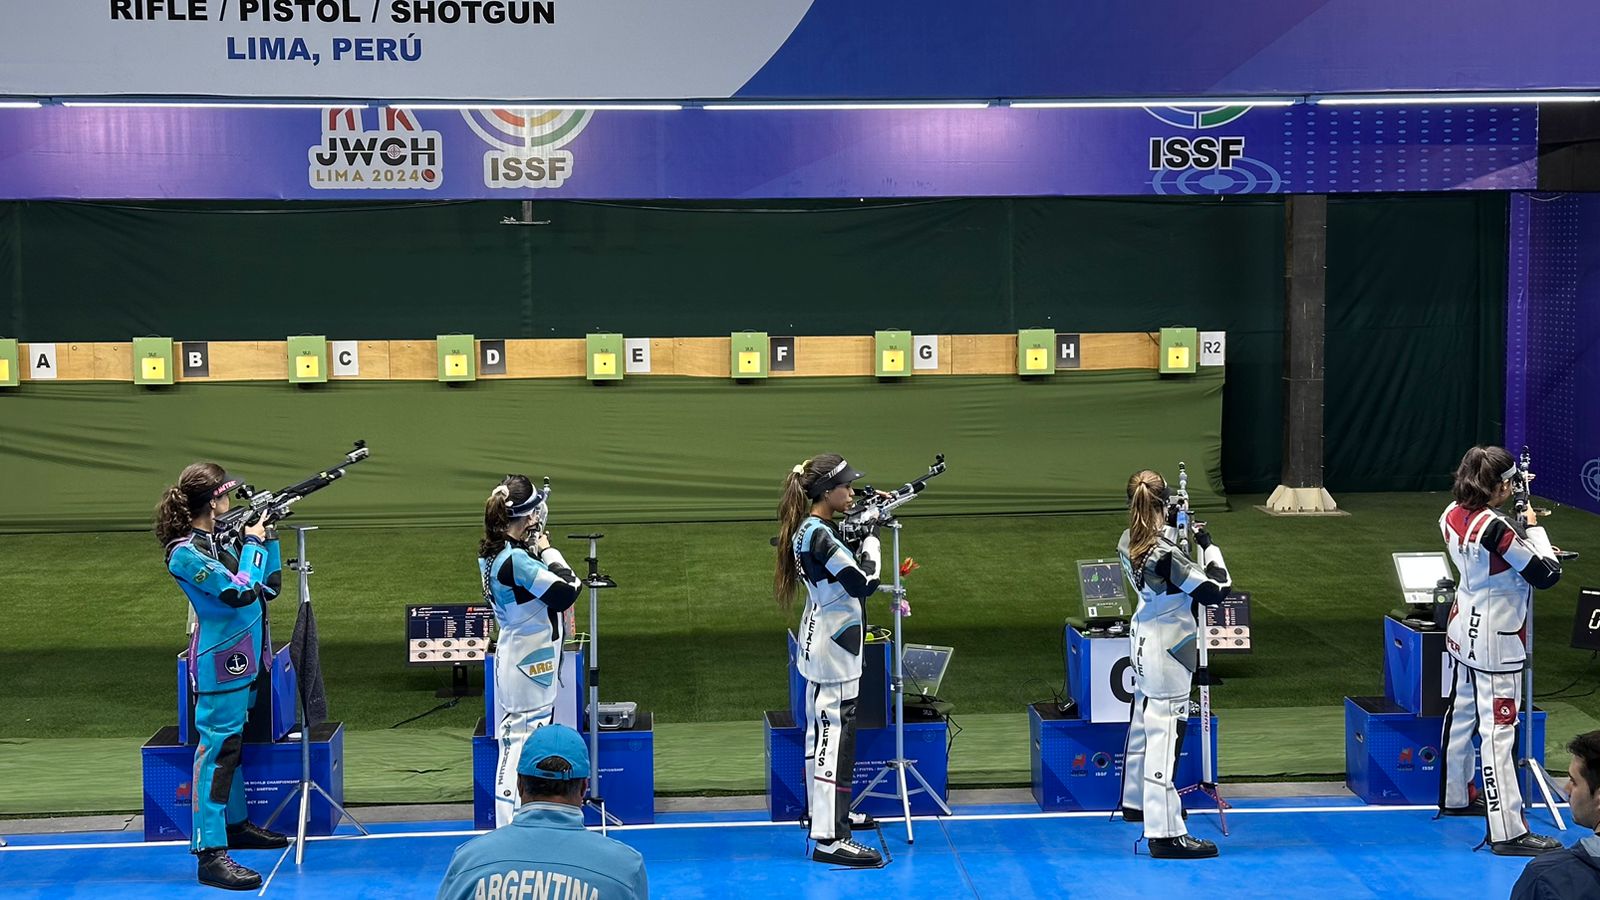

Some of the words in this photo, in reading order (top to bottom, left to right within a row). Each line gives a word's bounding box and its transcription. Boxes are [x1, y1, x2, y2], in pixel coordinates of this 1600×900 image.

[110, 0, 208, 20] RIFLE
[240, 0, 361, 22] PISTOL
[391, 0, 555, 24] SHOTGUN
[227, 37, 320, 66] LIMA,
[332, 33, 422, 61] PERÚ
[316, 137, 436, 166] JWCH
[1150, 137, 1244, 170] ISSF
[316, 169, 365, 182] LIMA
[372, 169, 419, 182] 2024
[491, 157, 567, 181] ISSF
[632, 347, 643, 363] E
[776, 346, 788, 362] F
[919, 344, 933, 360] G
[1061, 344, 1075, 359] H
[1203, 341, 1222, 355] R2
[36, 353, 51, 369] A
[188, 352, 203, 368] B
[338, 350, 353, 366] C
[486, 349, 500, 365] D
[1468, 605, 1482, 661] LUCIA
[529, 660, 554, 676] ARG
[818, 709, 831, 767] ARENAS
[1483, 766, 1500, 812] CRUZ
